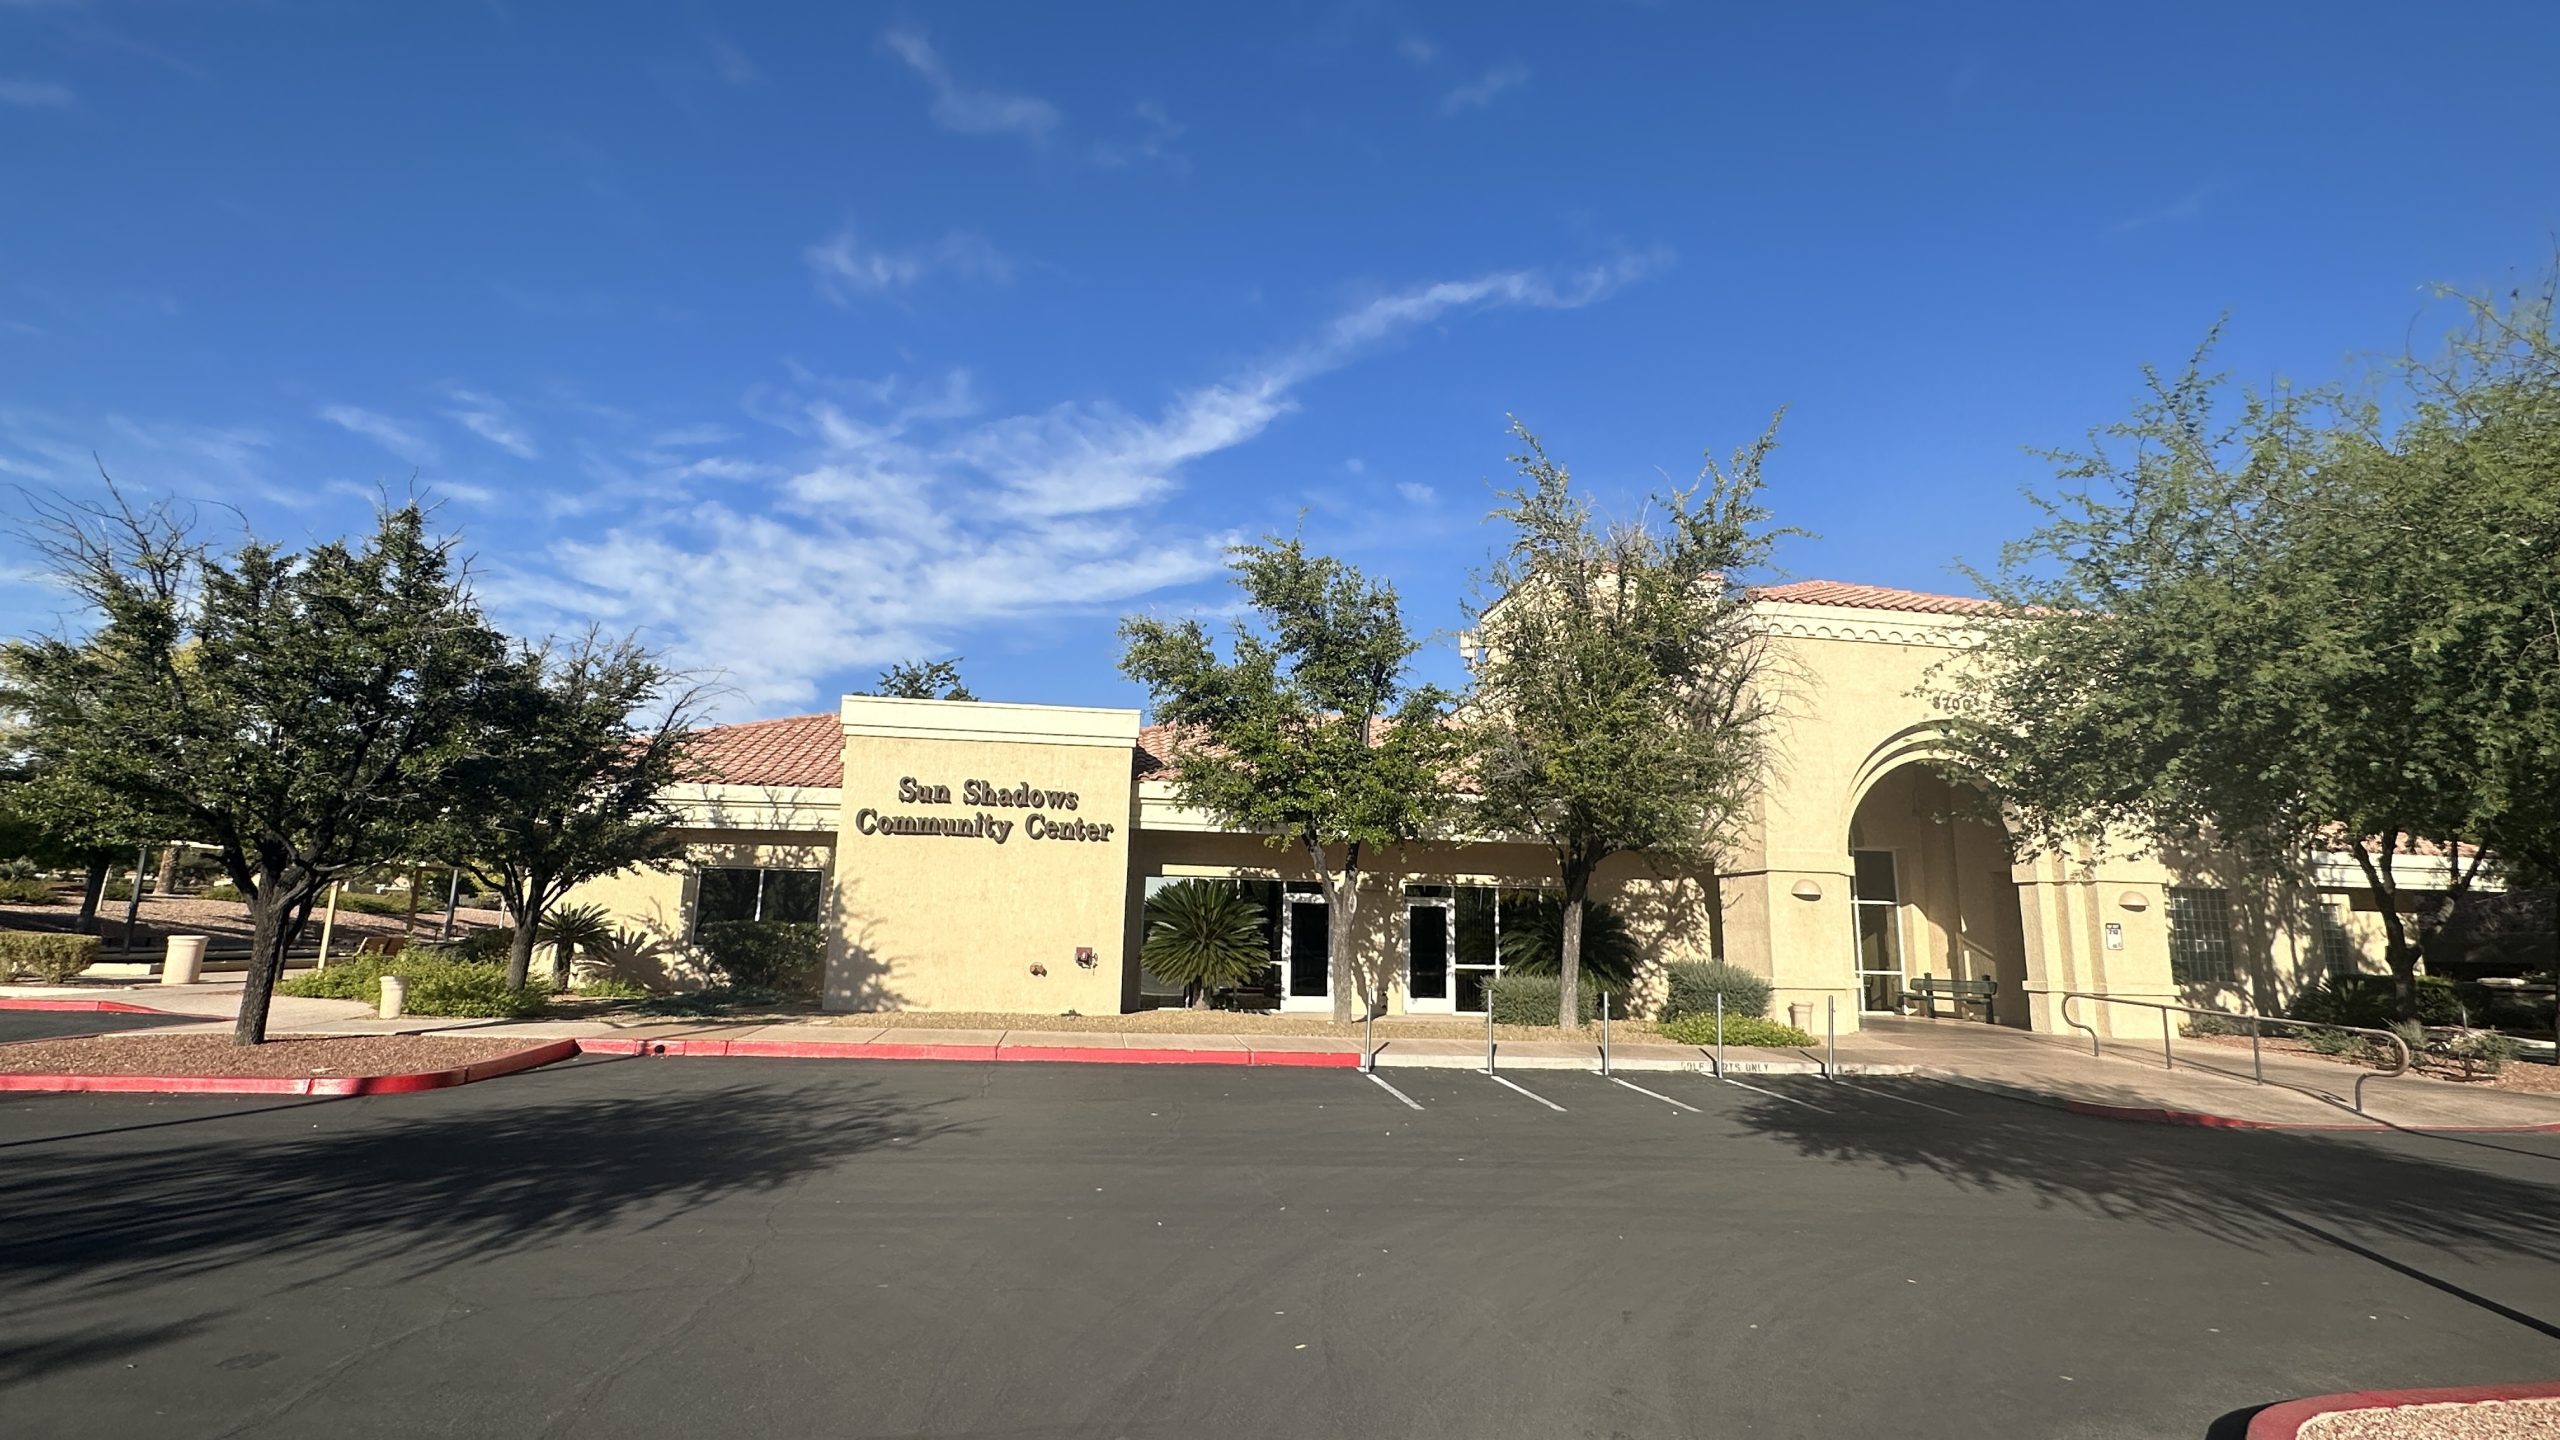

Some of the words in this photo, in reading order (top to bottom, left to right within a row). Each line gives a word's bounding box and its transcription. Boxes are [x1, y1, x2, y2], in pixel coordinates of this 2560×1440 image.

[899, 776, 951, 804] Sun
[962, 779, 1079, 811] Shadows
[855, 808, 1014, 844] Community
[1025, 813, 1115, 842] Center
[1745, 1063, 1769, 1073] ONLY
